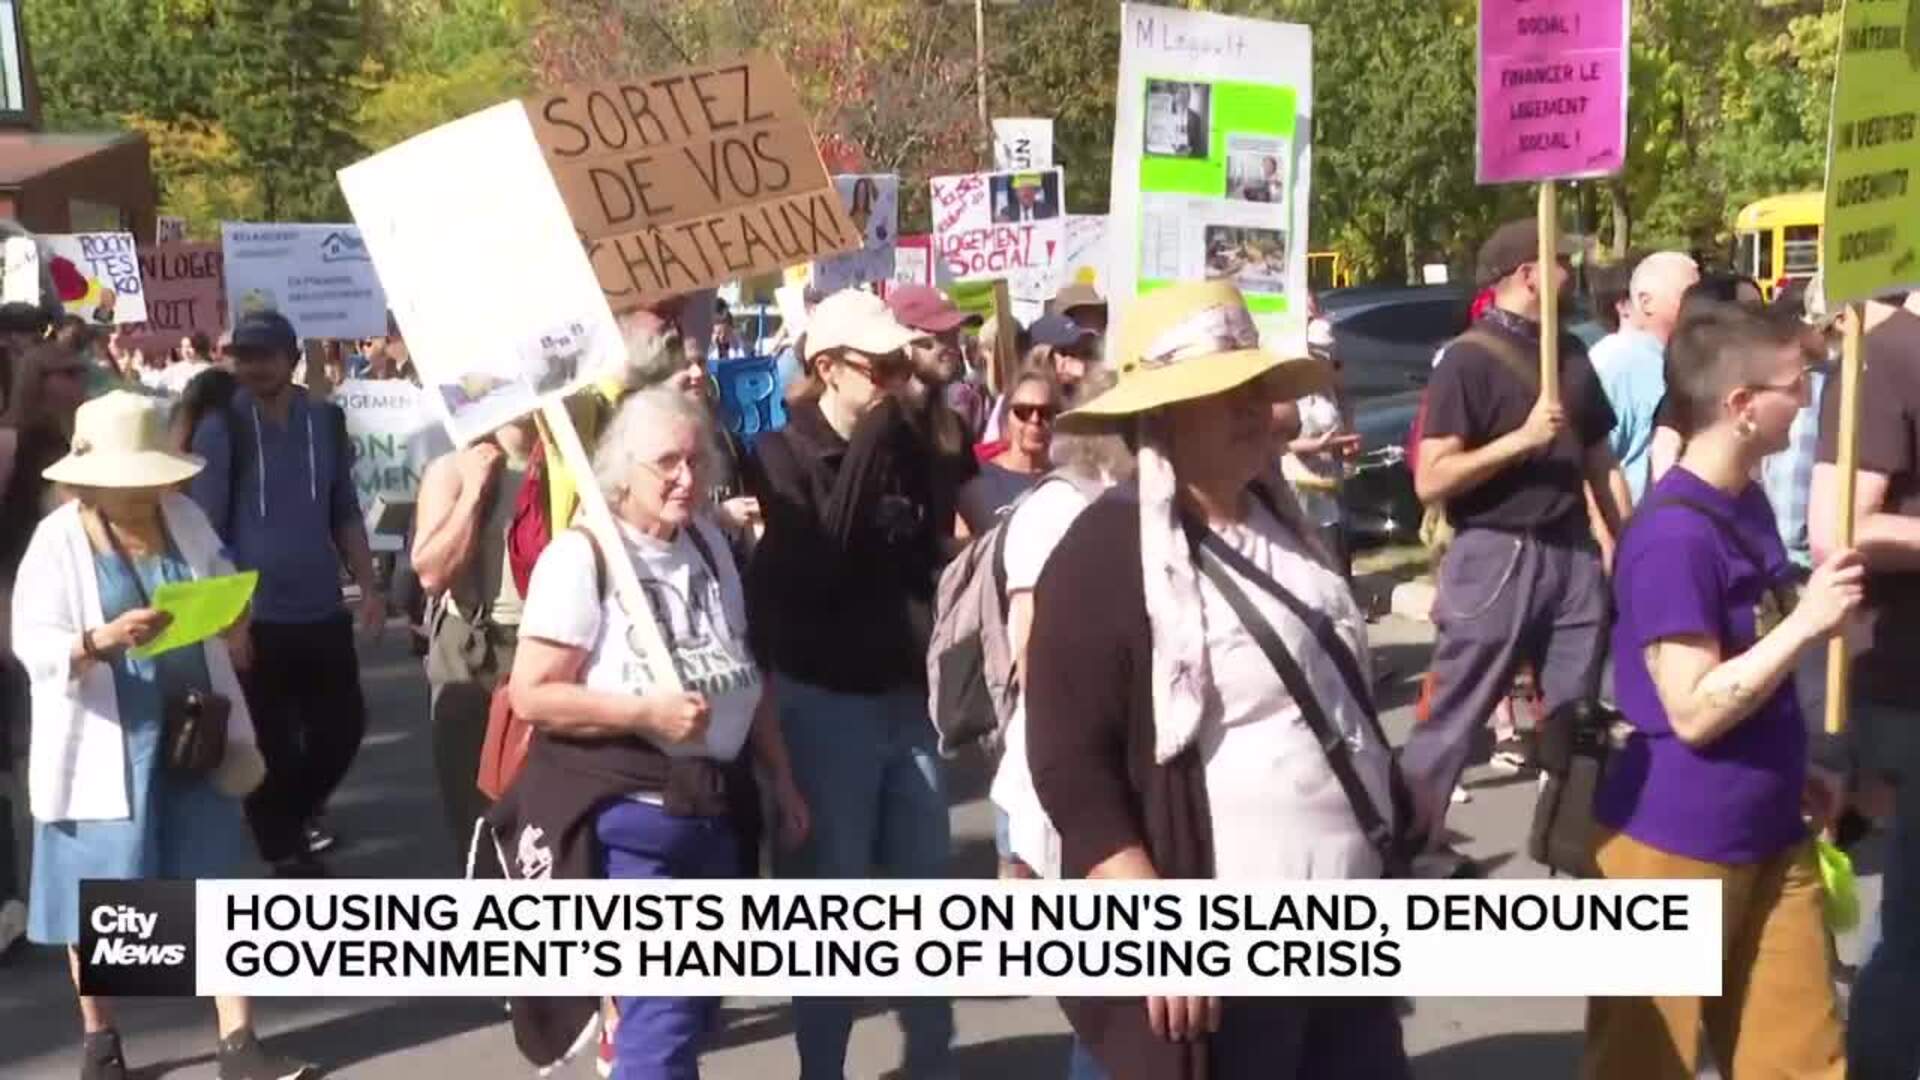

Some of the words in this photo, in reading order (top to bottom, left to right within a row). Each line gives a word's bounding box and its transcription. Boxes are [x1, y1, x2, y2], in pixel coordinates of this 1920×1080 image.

[1501, 64, 1573, 87] FINANCER
[1579, 61, 1601, 82] LE
[543, 65, 774, 156] SORTEZ
[1510, 96, 1590, 121] LOGEMENT
[588, 157, 673, 224] DE
[682, 131, 791, 203] VOS
[940, 225, 1035, 258] LOGEMENT
[948, 247, 1044, 277] SOCIAL
